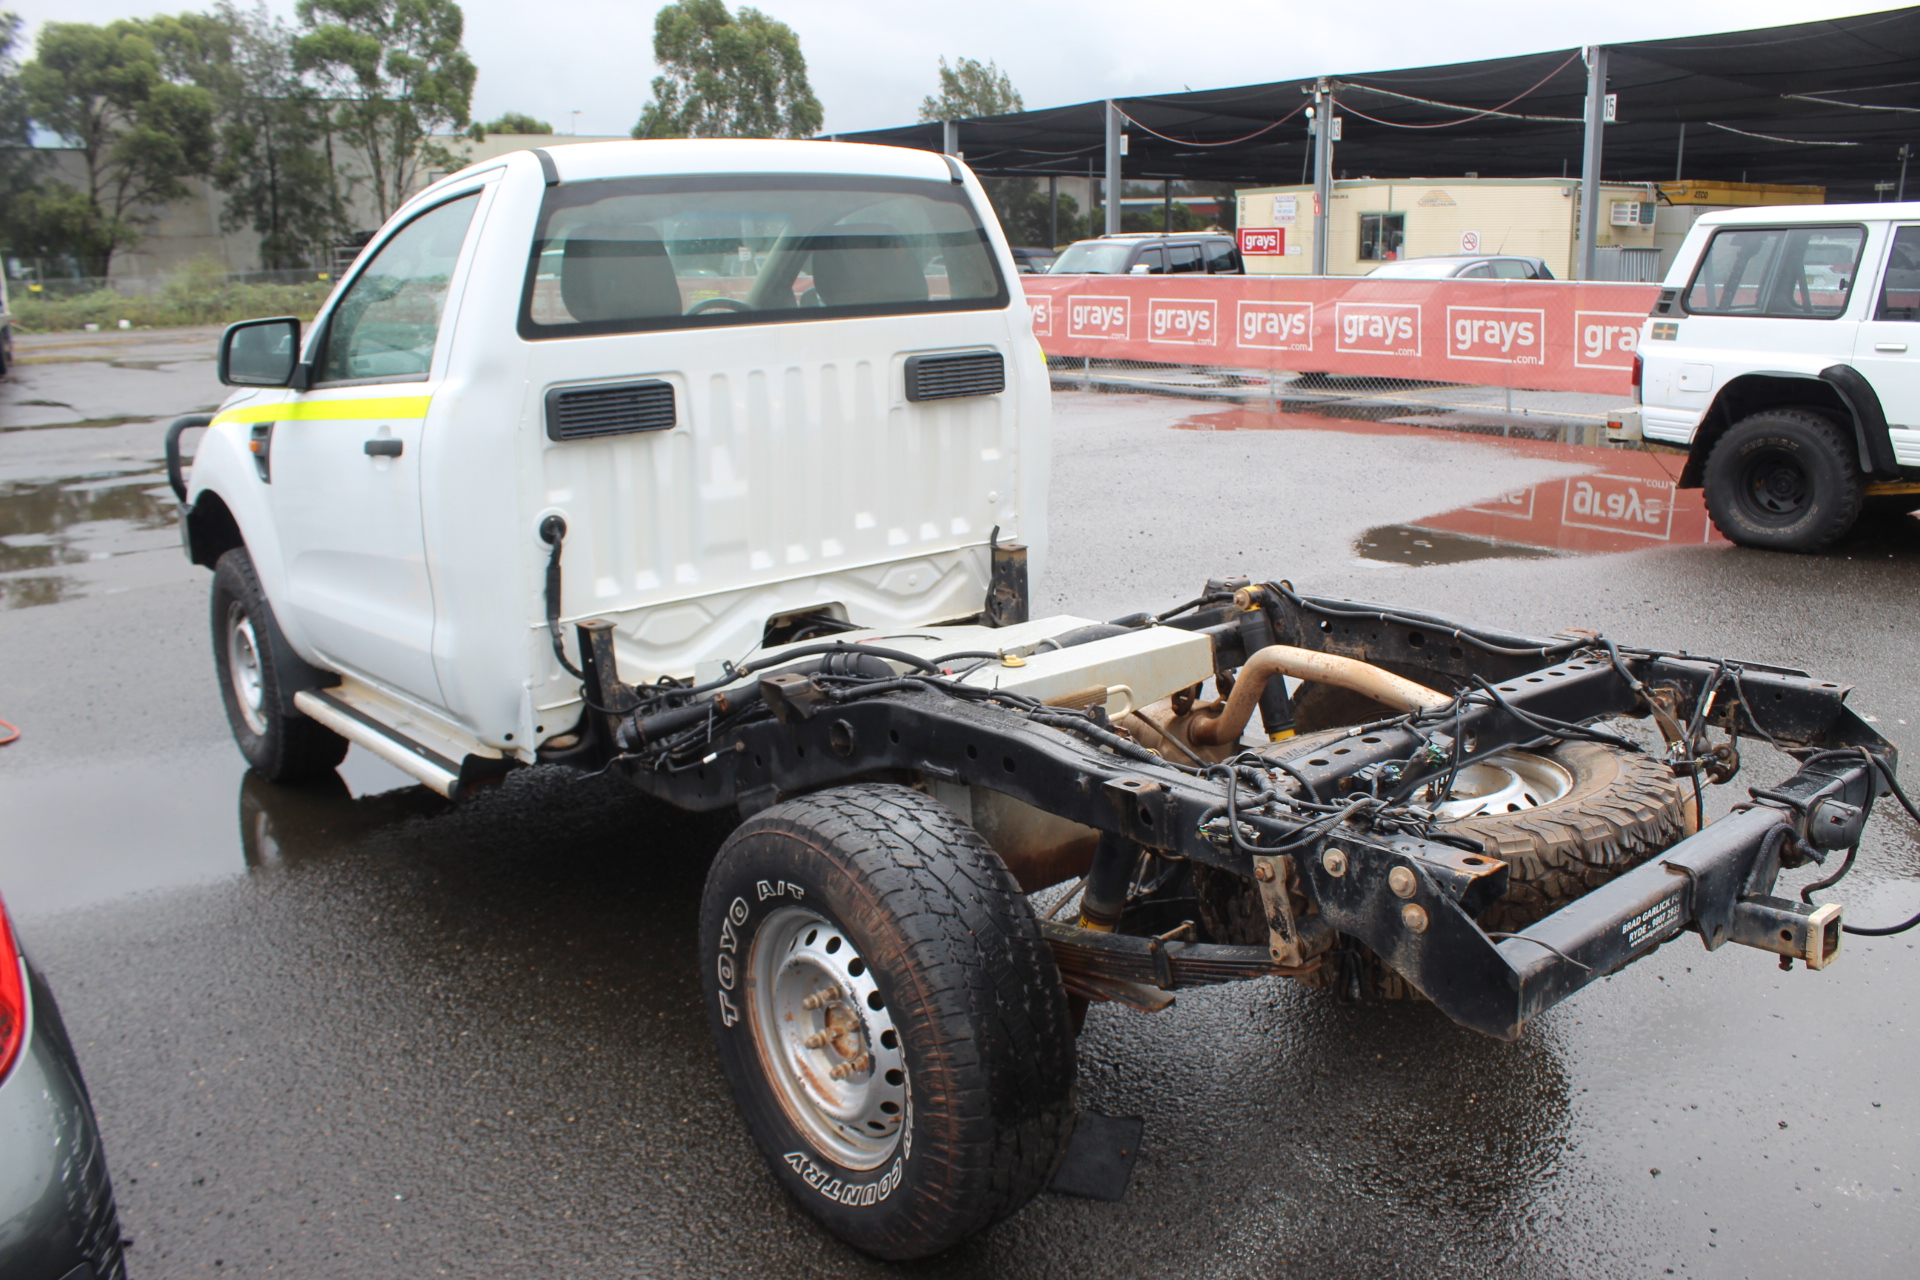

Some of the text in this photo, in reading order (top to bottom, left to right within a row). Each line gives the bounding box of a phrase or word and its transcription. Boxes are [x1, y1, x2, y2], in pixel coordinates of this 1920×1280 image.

[1605, 97, 1615, 118] 15
[1333, 120, 1340, 138] 13
[1245, 235, 1276, 250] grays
[1073, 303, 1124, 330] grays
[1154, 305, 1210, 336] grays
[1243, 308, 1305, 341] grays
[1343, 313, 1413, 345] grays
[1455, 318, 1535, 353] grays
[1584, 324, 1642, 358] gra
[1512, 354, 1538, 365] .com
[1622, 915, 1642, 934] BRAD
[1642, 897, 1671, 922] GARLICK
[1628, 923, 1647, 943] RYDE
[717, 896, 749, 1028] TOYO
[783, 1156, 902, 1207] COUNTRY
